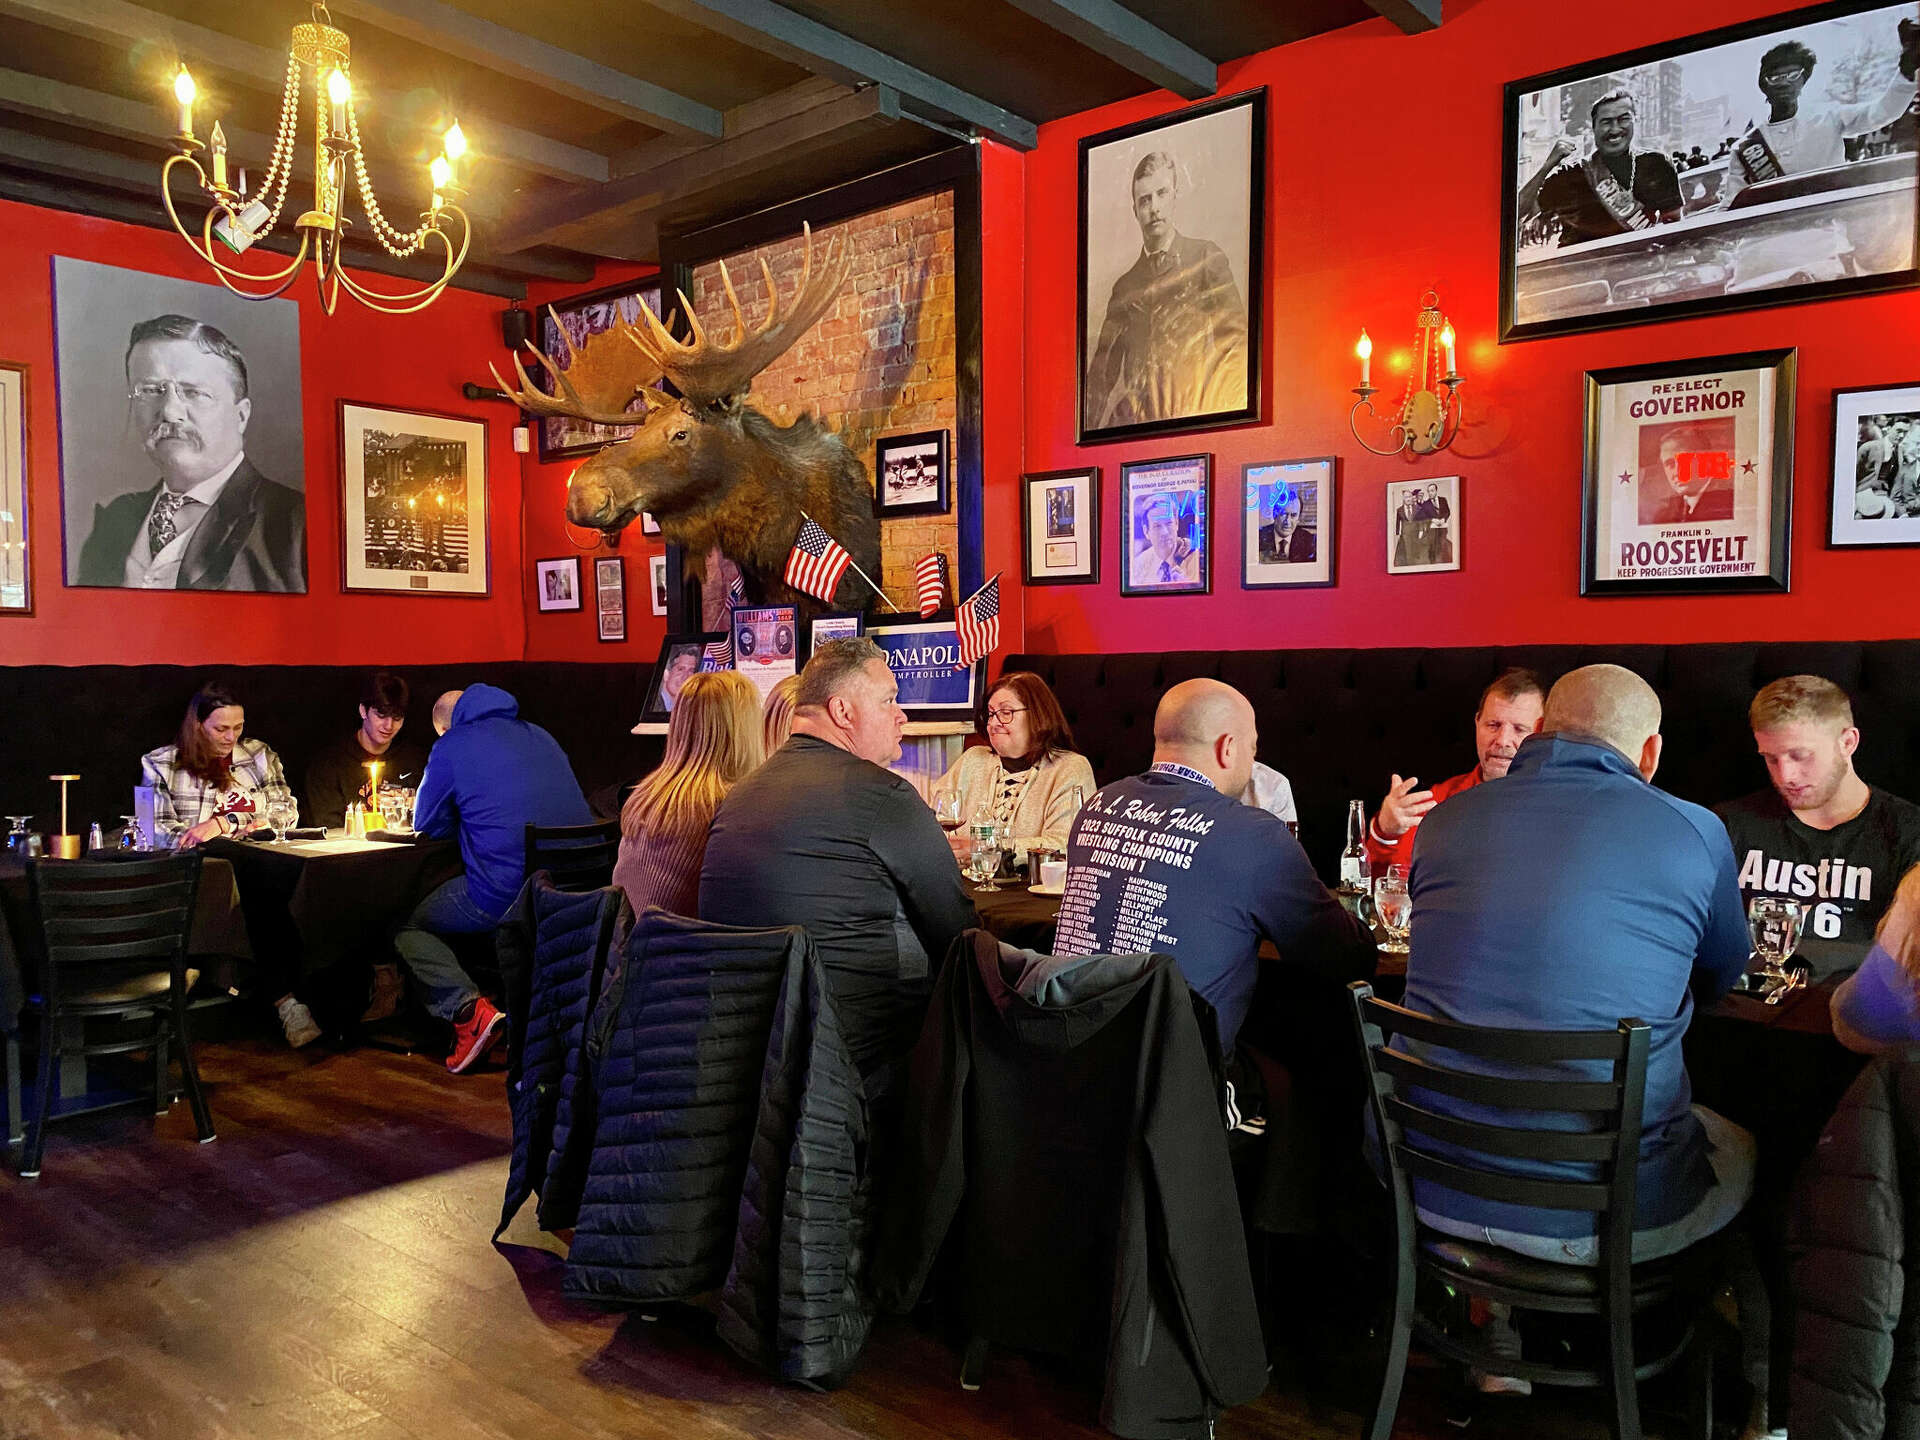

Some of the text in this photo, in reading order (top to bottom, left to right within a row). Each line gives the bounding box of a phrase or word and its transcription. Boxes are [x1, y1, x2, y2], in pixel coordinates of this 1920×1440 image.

[1596, 178, 1634, 216] GRAD
[1652, 378, 1722, 394] RE-ELECT
[1630, 390, 1746, 418] GOVERNOR
[1132, 482, 1156, 490] GOVERNOR
[1660, 528, 1712, 538] FRANKLIN D.
[1621, 536, 1748, 566] ROOSEVELT
[1617, 562, 1756, 578] KEEP PROGRESSIVE GOVERNMENT
[894, 670, 952, 680] MPTROLLER
[1086, 792, 1214, 836] Dr. L. Robert Fallot
[1080, 819, 1199, 854] 2023 SUFFOLK COUNTY
[1076, 833, 1192, 870] WRESTLING CHAMPIONS
[1090, 850, 1138, 872] DIVISION
[1138, 860, 1146, 873] 1
[1128, 876, 1168, 892] HAUPPAUGE
[1738, 850, 1872, 901] Austin
[1124, 892, 1164, 908] NORTHPORT
[1126, 884, 1167, 901] BRENTWOOD
[1122, 899, 1155, 914] BELLPORT
[1118, 914, 1162, 932] ROCKY POINT
[1120, 906, 1168, 926] MILLER PLACE
[1114, 930, 1152, 946] HAUPPAUGE
[1116, 922, 1178, 946] SMITHTOWN WEST
[1112, 938, 1152, 953] KINGS PARK
